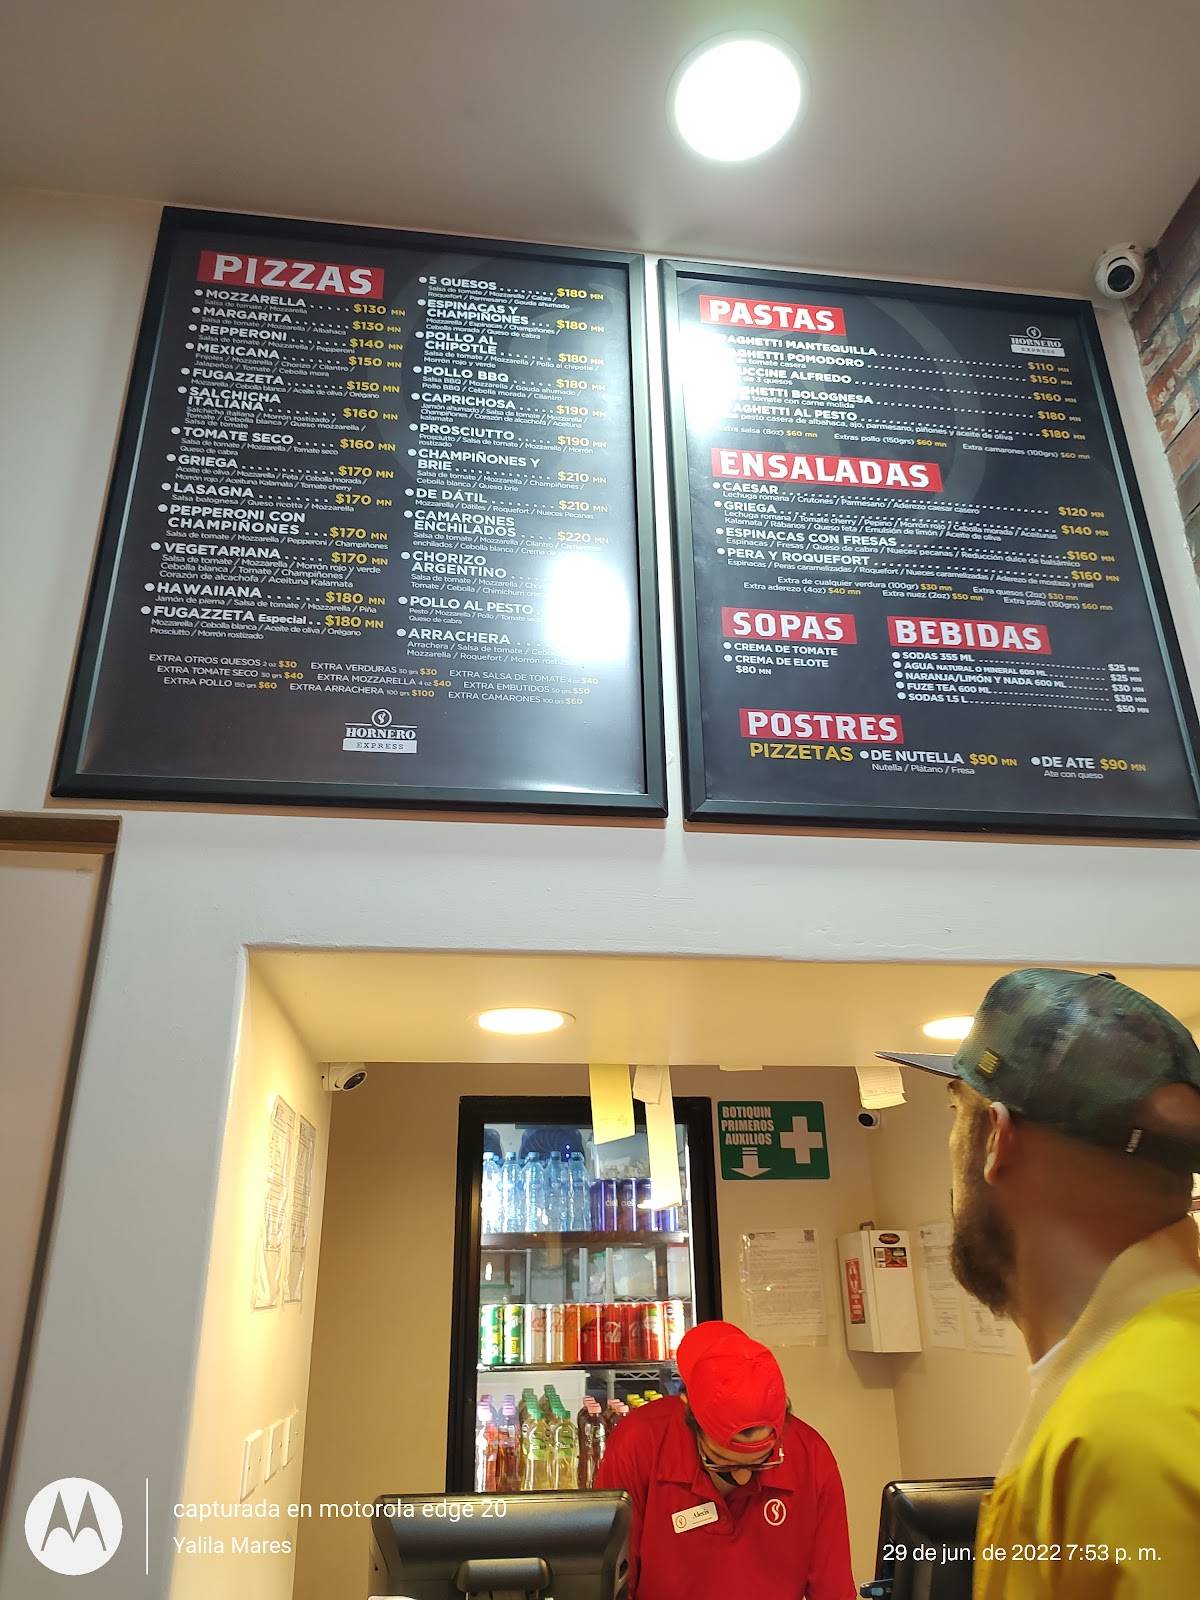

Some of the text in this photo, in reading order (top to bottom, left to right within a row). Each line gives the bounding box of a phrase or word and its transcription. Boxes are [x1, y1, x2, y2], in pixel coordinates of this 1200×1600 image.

[213, 255, 372, 296] PIZZAS
[441, 277, 497, 290] QUESOS
[206, 290, 406, 317] MOZZARELLA $130 MN
[427, 300, 519, 315] ESPINACAS Y
[203, 307, 292, 323] MARGARITA
[427, 308, 588, 330] CHAMPIÑONES $180
[709, 299, 835, 332] PASTAS
[200, 325, 384, 349] PEPPERONI $140
[425, 331, 498, 346] POLLO AL
[1011, 338, 1061, 347] HORNERO
[197, 343, 280, 359] MEXICANA
[425, 341, 497, 355] CHIPOTLE
[786, 340, 1054, 372] MANTEQUILLA $110
[788, 353, 864, 368] POMODORO
[193, 369, 380, 392] FUGAZZETA $150
[423, 366, 509, 383] POLLO BBQ
[791, 371, 1061, 402] ALFREDO $160
[190, 387, 280, 403] SALCHICHA
[422, 393, 516, 410] CAPRICHOSA
[792, 388, 873, 404] BOLOGNESA
[188, 396, 264, 411] ITALIANA
[794, 407, 857, 421] AL PESTO
[183, 427, 248, 442] TOMATE
[252, 431, 294, 445] SECO
[340, 439, 374, 450] $160
[420, 424, 515, 440] PROSCIUTTO
[178, 454, 238, 468] GRIEGA
[418, 460, 452, 471] BRIE
[419, 449, 541, 468] CHAMPIÑONES Y
[720, 451, 929, 488] ENSALADAS
[173, 482, 371, 506] LASAGNA $170
[723, 482, 778, 494] CAESAR
[416, 489, 589, 511] DE DÁTIL $210
[170, 504, 305, 523] PEPPERONI CON
[415, 510, 515, 526] CAMARONES
[724, 501, 777, 514] GRIEGA
[1061, 525, 1092, 535] $140
[168, 518, 300, 535] CHAMPIÑONES
[415, 520, 517, 537] ENCHILADOS
[726, 528, 897, 546] ESPINACAS CON FRESAS
[164, 542, 367, 565] VEGETARIANA $170
[413, 551, 486, 565] CHORIZO
[161, 562, 195, 571] Cebolla
[238, 566, 272, 575] Tomate
[281, 569, 343, 580] Champiñones
[412, 561, 507, 578] ARGENTINO
[727, 548, 1101, 581] PERA Y ROQUEFORT $160
[157, 583, 262, 598] HAWAIIANA
[813, 579, 852, 587] cualquier
[854, 580, 886, 588] verdura
[410, 596, 534, 614] POLLO AL PESTO
[154, 606, 383, 628] FUGAZZETA Especial $180 MN
[733, 611, 843, 641] SOPAS
[408, 629, 510, 645] ARRACHERA
[895, 620, 1042, 650] BEBIDAS
[734, 643, 838, 656] CREMA DE TOMATE
[902, 652, 937, 660] SODAS
[149, 654, 297, 668] EXTRA OTROS QUESOS $30
[735, 655, 829, 667] CREMA DE ELOTE
[904, 662, 934, 670] AGUA
[736, 665, 756, 674] $80
[164, 677, 232, 687] EXTRA POLLO
[907, 683, 935, 691] FUZE
[936, 684, 956, 692] TEA
[1003, 678, 1033, 686] NADA
[909, 693, 968, 703] SODAS L
[345, 727, 416, 739] HORNERO
[748, 711, 897, 741] POSTRES
[357, 742, 404, 750] EXPRESS
[750, 742, 1127, 771] PIZZETAS DE NUTELLA $90 DE ATE $90
[872, 763, 902, 771] Nutella
[952, 766, 975, 774] Fresa
[1044, 770, 1059, 778] Ate
[1078, 772, 1104, 780] queso
[722, 1106, 771, 1119] BOTIQUIN
[722, 1120, 774, 1131] PRIMEROS
[726, 1133, 772, 1145] AUXILIOS
